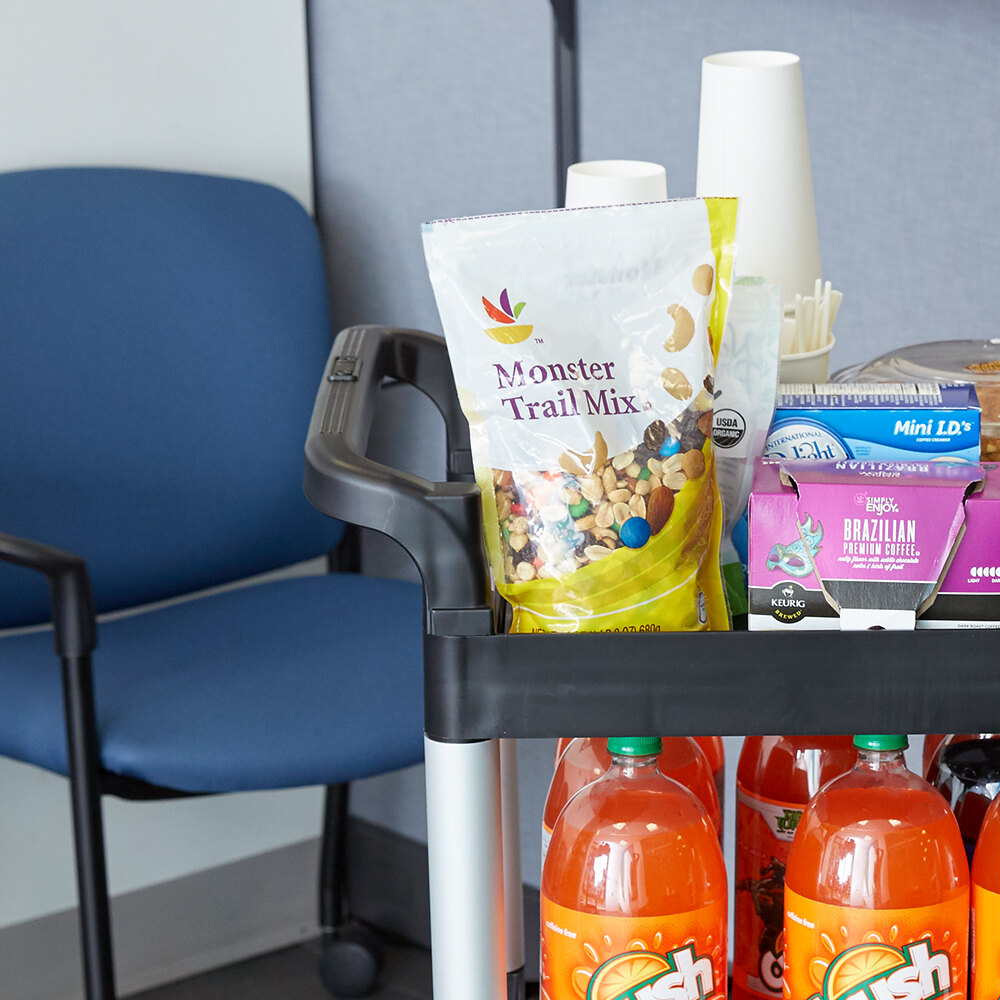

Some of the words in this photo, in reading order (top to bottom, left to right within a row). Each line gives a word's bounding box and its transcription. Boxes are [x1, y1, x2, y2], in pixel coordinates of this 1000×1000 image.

[492, 358, 615, 389] Monster
[501, 388, 580, 420] Trail
[583, 388, 641, 416] Mix
[716, 417, 738, 428] USDA
[894, 419, 933, 436] Mini
[936, 420, 972, 436] I.D.'s
[713, 428, 740, 439] ORGANIC
[765, 431, 822, 451] INTERNATIONAL
[866, 496, 895, 504] SIMPLY
[843, 518, 916, 543] BRAZILIAN
[843, 542, 882, 555] PREMIUM
[885, 543, 916, 556] COFFEE
[771, 598, 806, 608] KEURIG
[774, 608, 802, 620] BREWED
